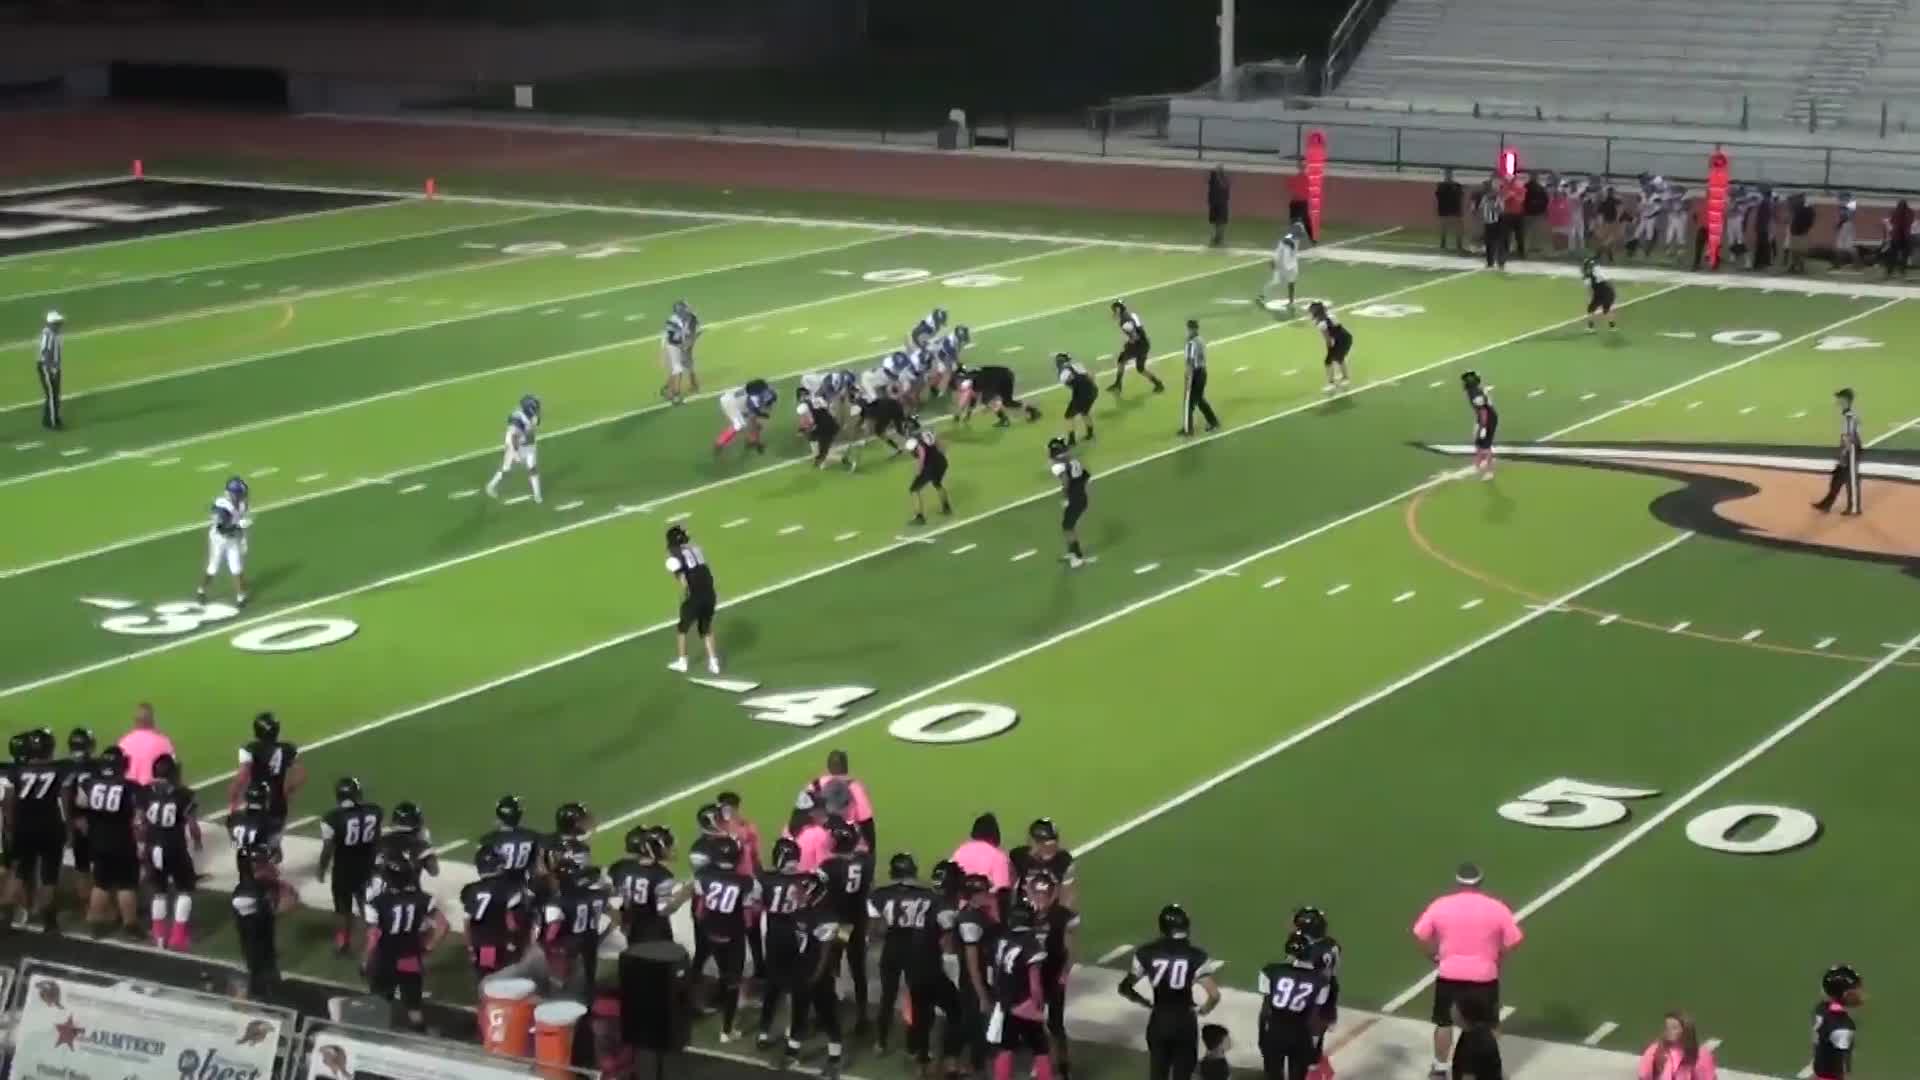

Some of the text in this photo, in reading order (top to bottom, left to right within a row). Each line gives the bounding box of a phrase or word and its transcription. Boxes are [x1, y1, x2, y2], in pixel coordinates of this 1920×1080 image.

[268, 748, 283, 775] 4
[19, 772, 55, 799] 77
[90, 784, 124, 812] 66
[146, 803, 177, 828] 46
[345, 814, 377, 846] 62
[1497, 777, 1820, 853] 50
[845, 864, 862, 893] 5
[475, 892, 492, 920] 7
[705, 881, 740, 913] 20
[390, 904, 415, 935] 11
[1151, 958, 1189, 990] 70
[1272, 977, 1314, 1012] 92
